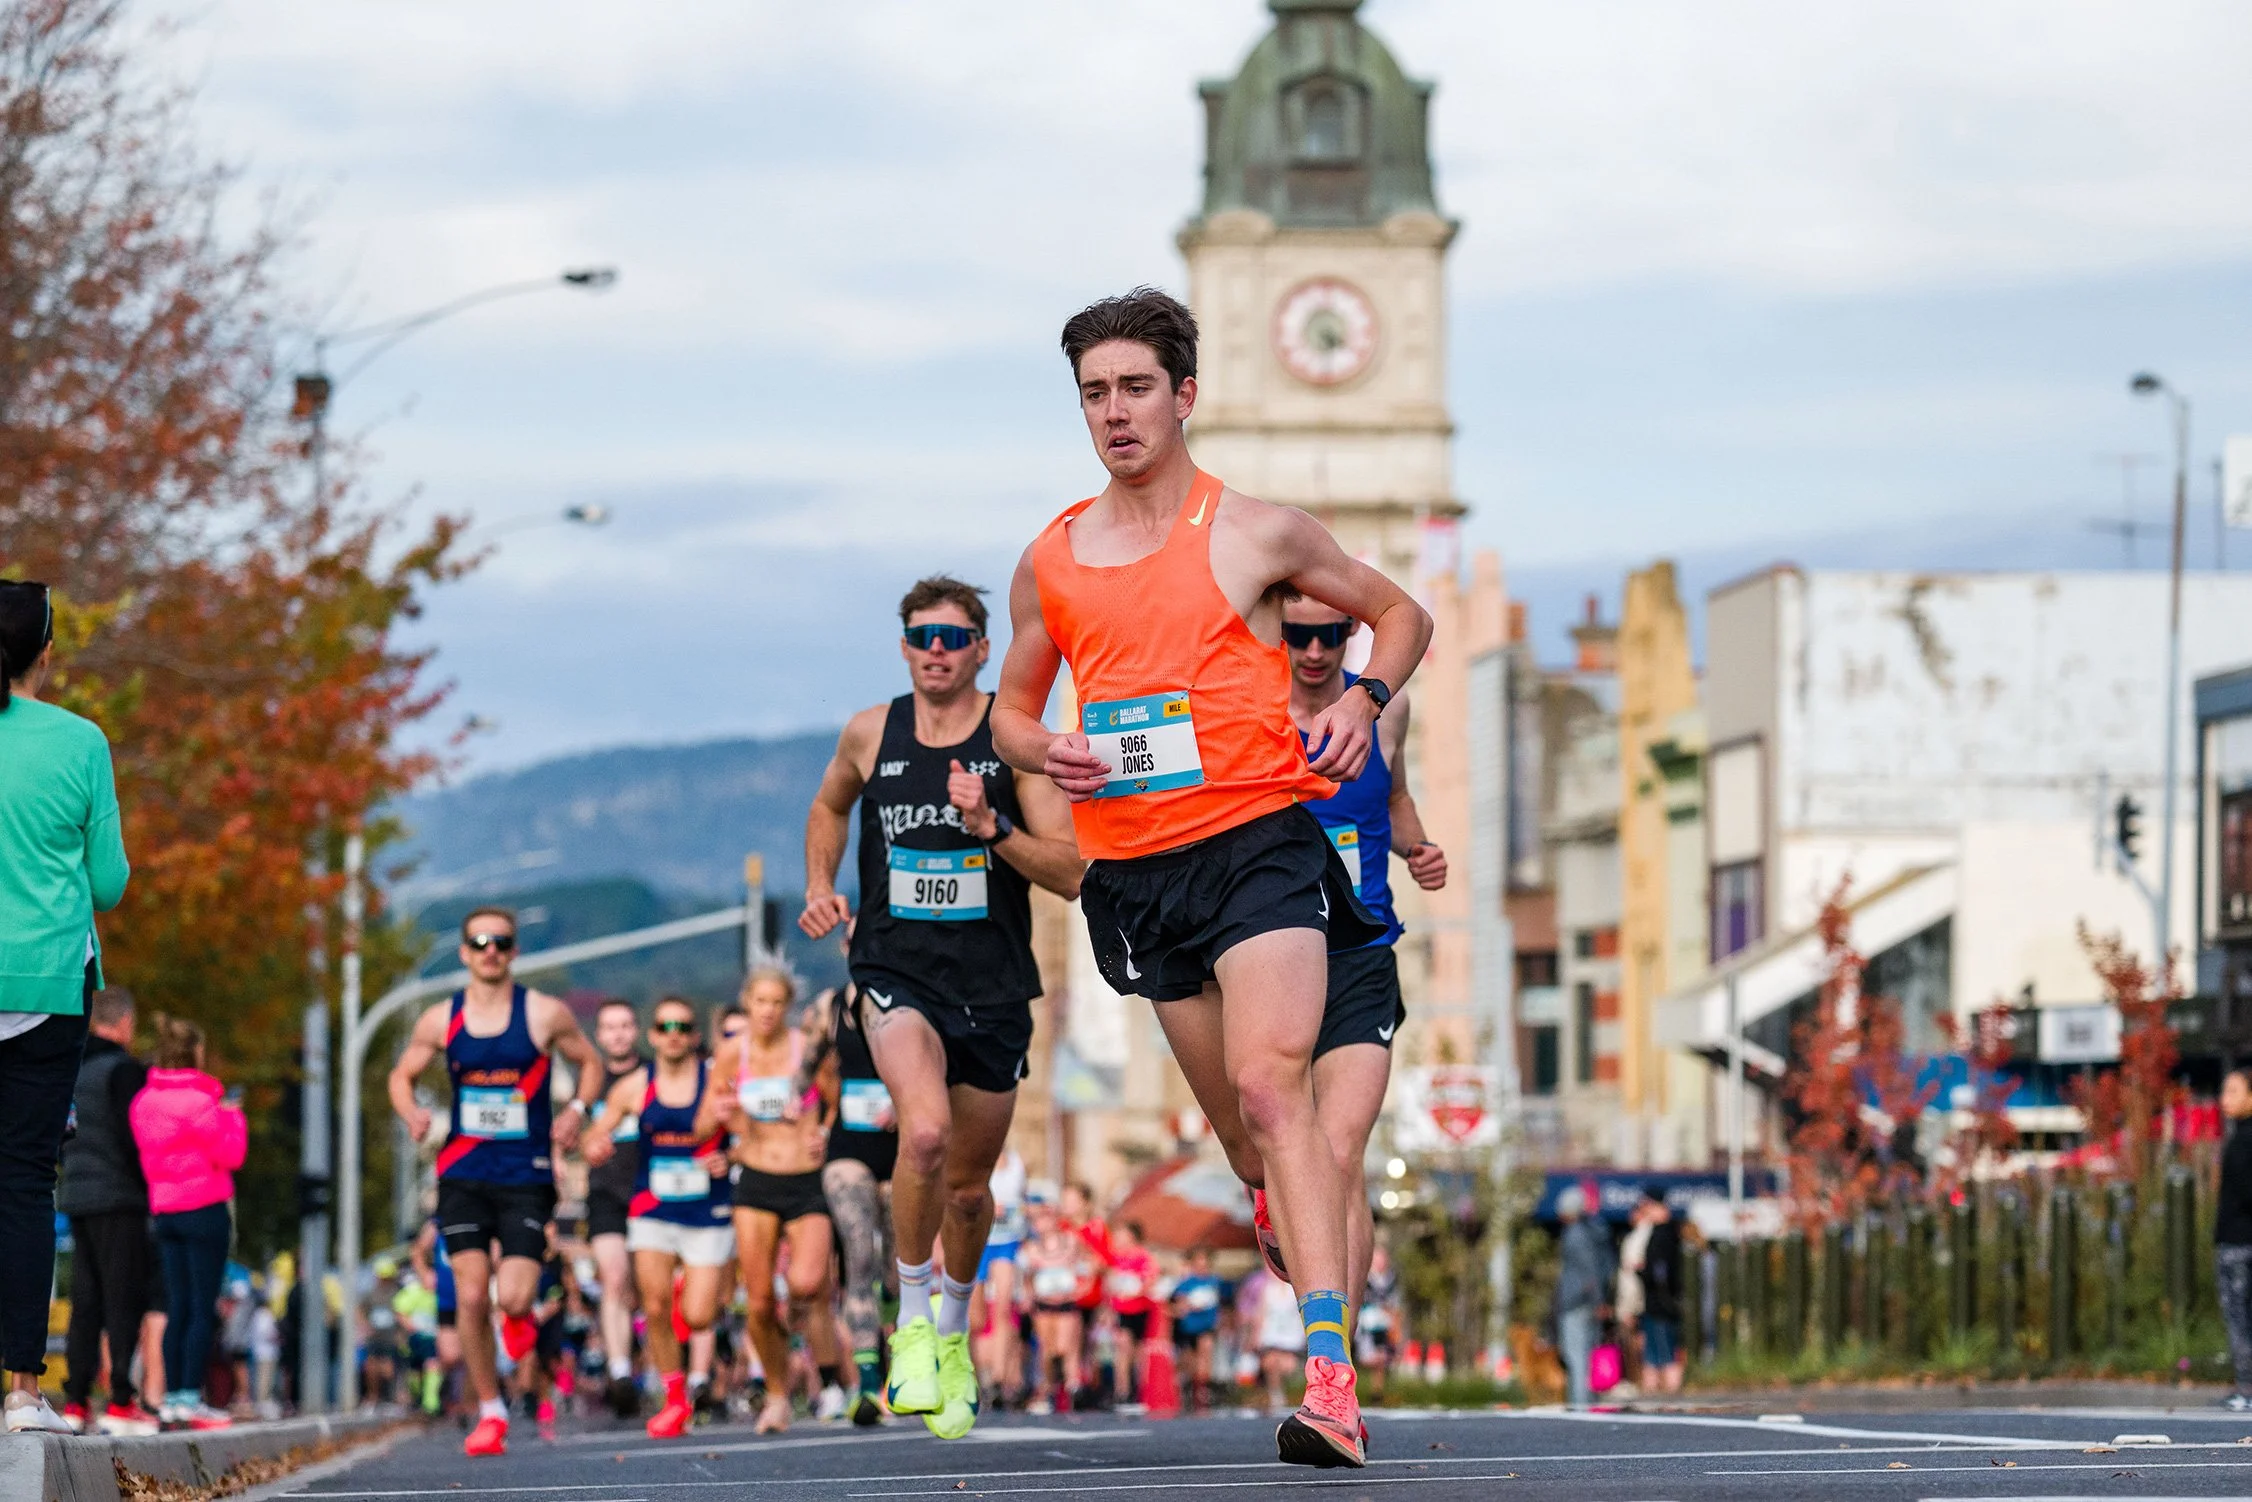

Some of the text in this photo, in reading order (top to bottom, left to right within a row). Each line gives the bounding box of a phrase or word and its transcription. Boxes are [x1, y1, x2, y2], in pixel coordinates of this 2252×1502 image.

[1120, 705, 1146, 716] BALLARAT
[1169, 703, 1181, 712] MILE
[1120, 713, 1149, 724] MARATHON
[1120, 734, 1147, 754] 9066
[1122, 753, 1154, 774] JONES
[914, 878, 958, 904] 9160
